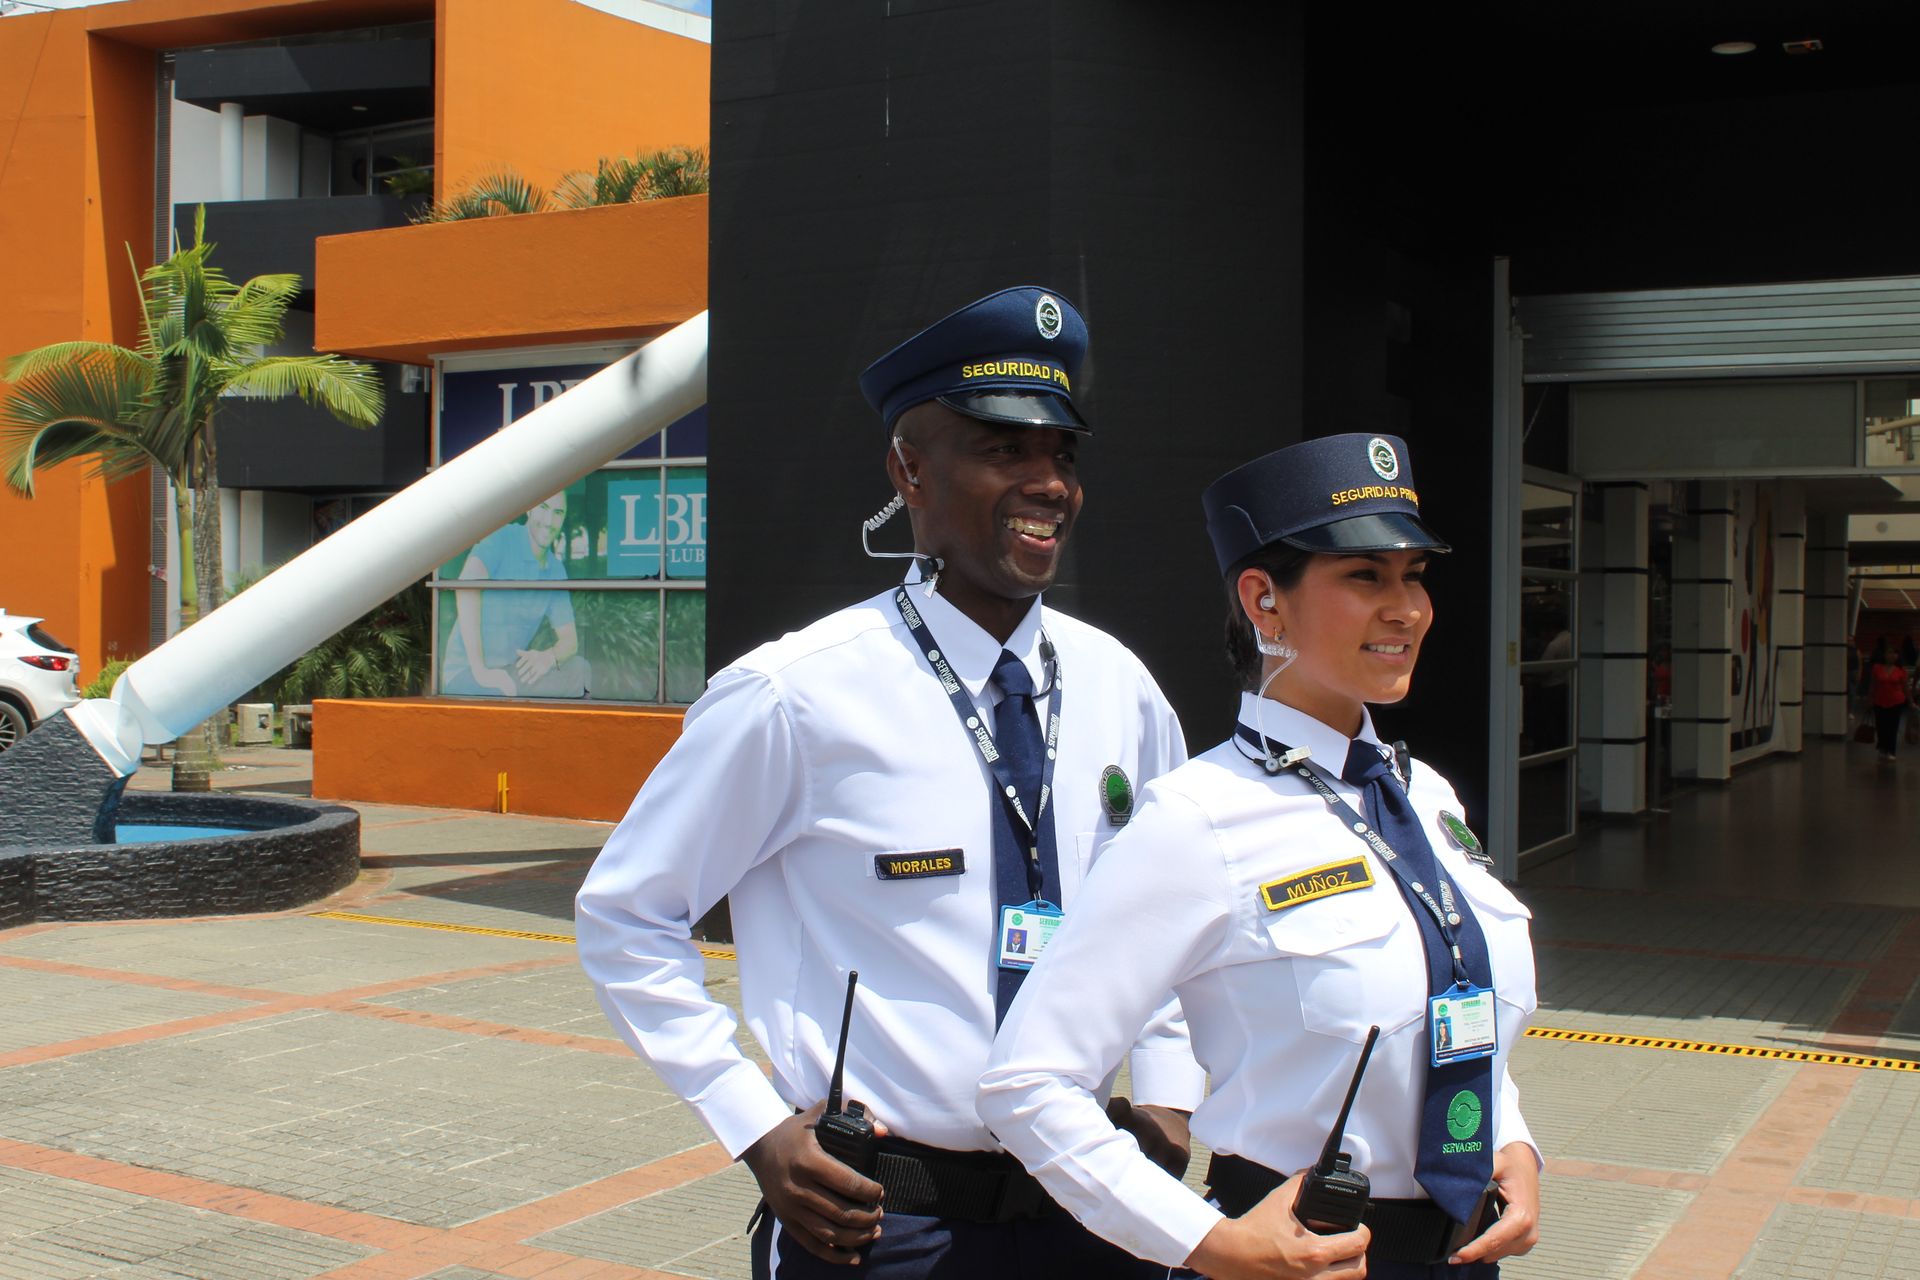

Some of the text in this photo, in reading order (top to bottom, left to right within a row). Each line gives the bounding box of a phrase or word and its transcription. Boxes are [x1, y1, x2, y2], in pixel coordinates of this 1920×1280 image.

[962, 361, 1051, 379] SEGURIDAD
[1331, 486, 1398, 506] SEGURIDAD
[900, 597, 922, 629] SERVAGRO
[935, 659, 960, 694] SERVAGRO
[974, 726, 1000, 763] SERVAGRO
[1309, 775, 1340, 804] SERVAGRO
[1364, 830, 1397, 861] SERVAGRO
[889, 857, 952, 874] MORALES
[1286, 871, 1352, 900] MUÑOZ
[1442, 1141, 1482, 1154] SERVAGRO
